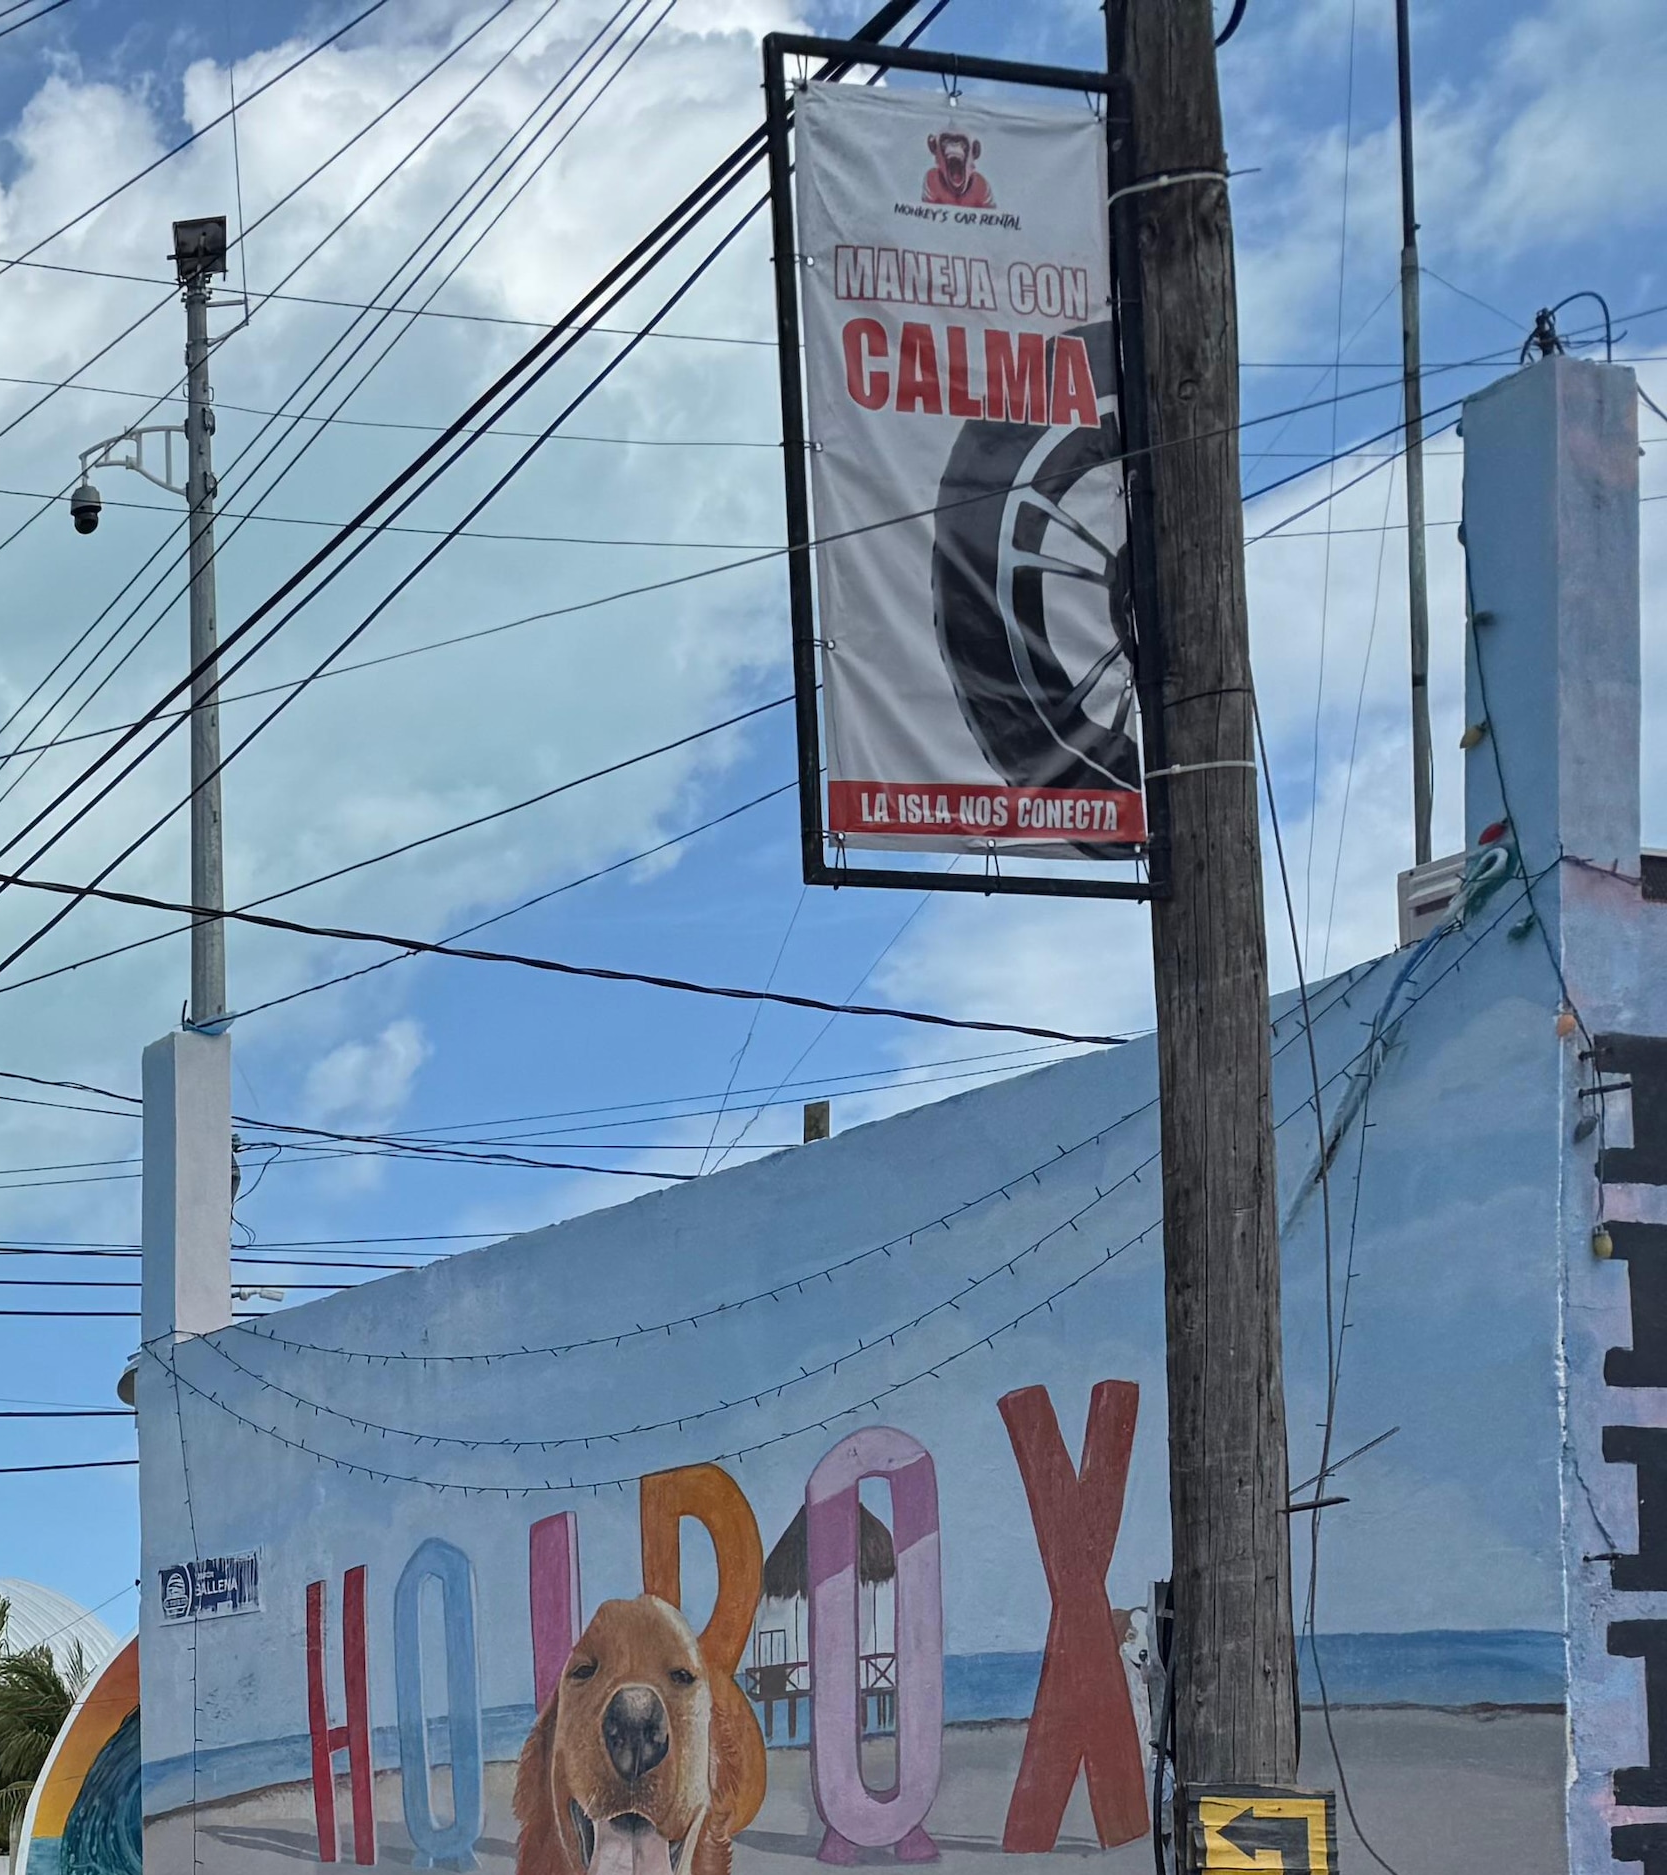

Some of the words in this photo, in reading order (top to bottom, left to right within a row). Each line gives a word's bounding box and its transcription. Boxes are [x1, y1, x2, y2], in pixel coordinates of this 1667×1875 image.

[894, 203, 948, 223] MONKEY'S
[954, 211, 977, 226] CAR
[979, 213, 1022, 231] RENTAL
[835, 245, 998, 311] MANEJA
[1008, 262, 1089, 322] CON
[841, 317, 1102, 430] CALMA
[861, 793, 890, 823] LA
[898, 794, 952, 825] ISLA
[959, 795, 1009, 827] NOS
[1017, 797, 1118, 831] CONECTA
